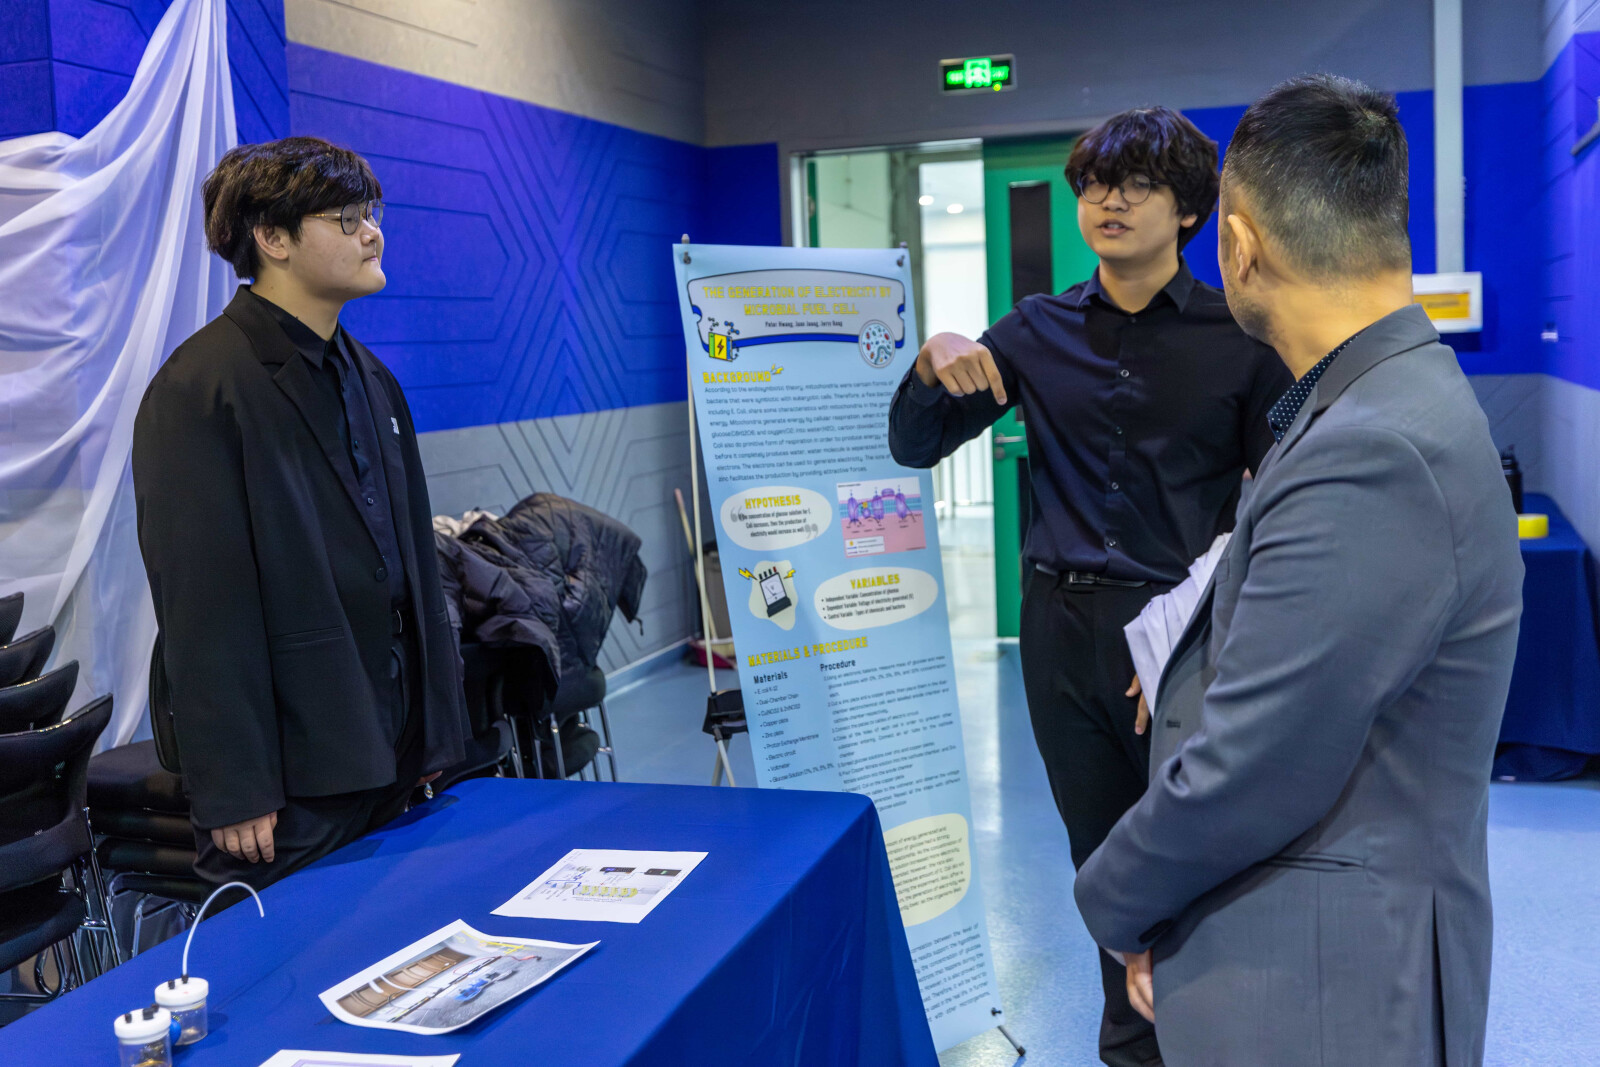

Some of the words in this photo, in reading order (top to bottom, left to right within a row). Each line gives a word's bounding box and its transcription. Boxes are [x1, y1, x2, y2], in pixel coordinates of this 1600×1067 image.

[704, 286, 724, 298] THE
[728, 286, 794, 298] GENERATION
[798, 286, 811, 297] OF
[815, 286, 876, 297] ELECTRICITY
[879, 286, 891, 297] BY
[744, 304, 800, 315] MICROBIAL
[802, 303, 830, 314] FUEL
[833, 303, 859, 314] CELL
[703, 371, 771, 383] BACKGROUND
[744, 494, 801, 509] HYPOTHESIS
[850, 574, 900, 590] VARIABLES
[748, 648, 800, 667] MATERIALS
[803, 646, 811, 657] &
[813, 636, 868, 656] PROCEDURE
[820, 659, 856, 672] Procedure
[754, 671, 788, 684] Materials
